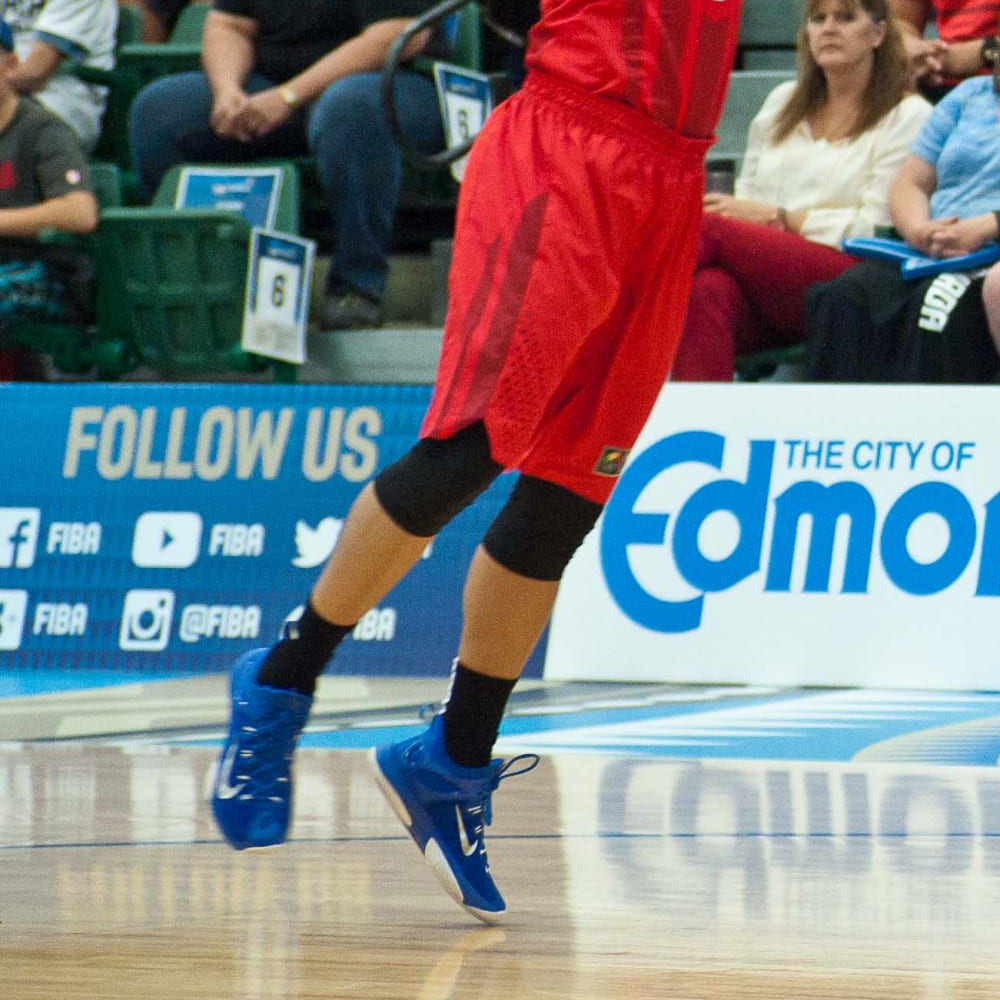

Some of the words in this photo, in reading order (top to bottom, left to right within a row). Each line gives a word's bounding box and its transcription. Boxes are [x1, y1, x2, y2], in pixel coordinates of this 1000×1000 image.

[272, 274, 286, 308] 6
[63, 405, 294, 481] FOLLOW
[303, 405, 382, 483] US
[783, 440, 843, 468] THE
[852, 440, 923, 470] CITY
[931, 442, 976, 472] OF
[47, 522, 102, 556] FIBA
[209, 523, 265, 557] FIBA
[34, 603, 88, 637] FIBA
[180, 604, 260, 641] @FIBA
